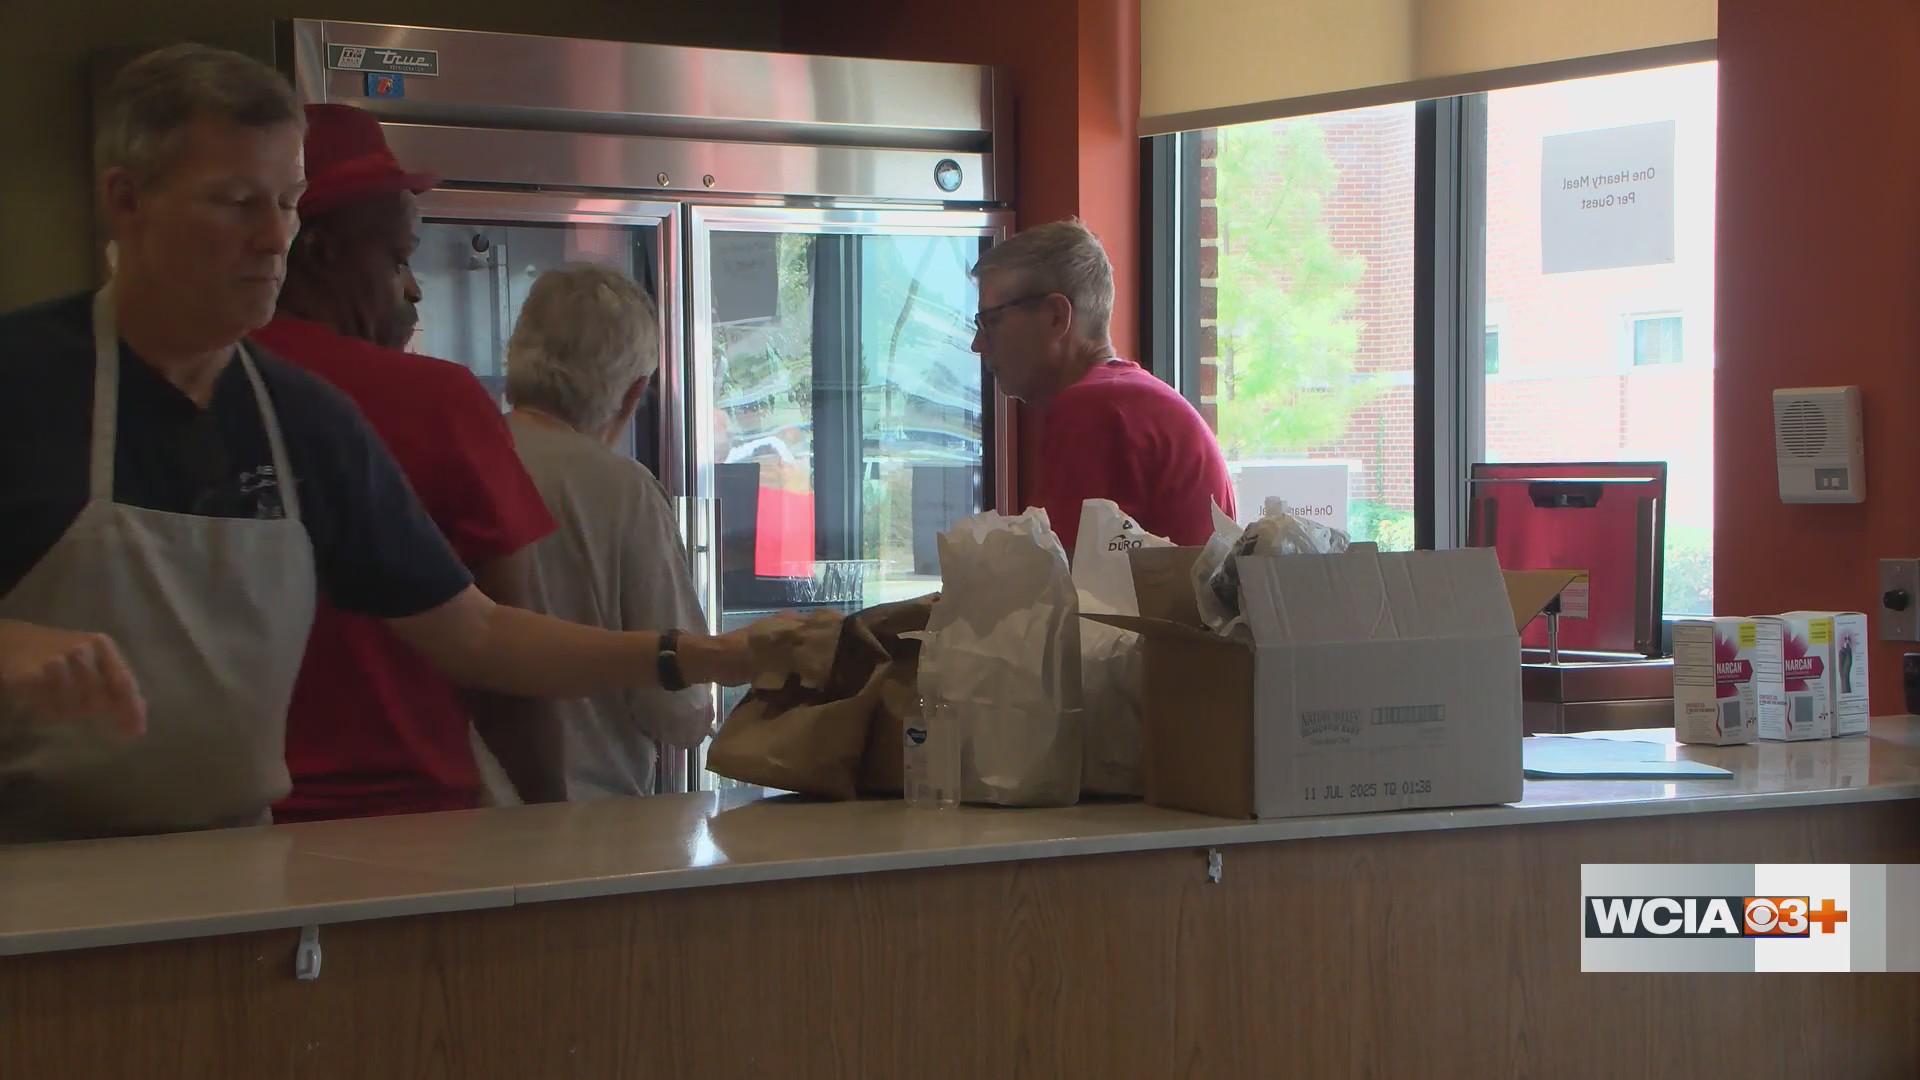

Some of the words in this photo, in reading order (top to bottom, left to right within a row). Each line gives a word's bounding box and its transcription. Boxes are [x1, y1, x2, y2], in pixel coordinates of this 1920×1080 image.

[1108, 540, 1142, 551] DURO
[1716, 662, 1742, 675] NARCAN
[1785, 658, 1812, 671] NARCAN
[1305, 787, 1316, 800] 11
[1324, 785, 1343, 799] JUL
[1350, 784, 1377, 797] 2025
